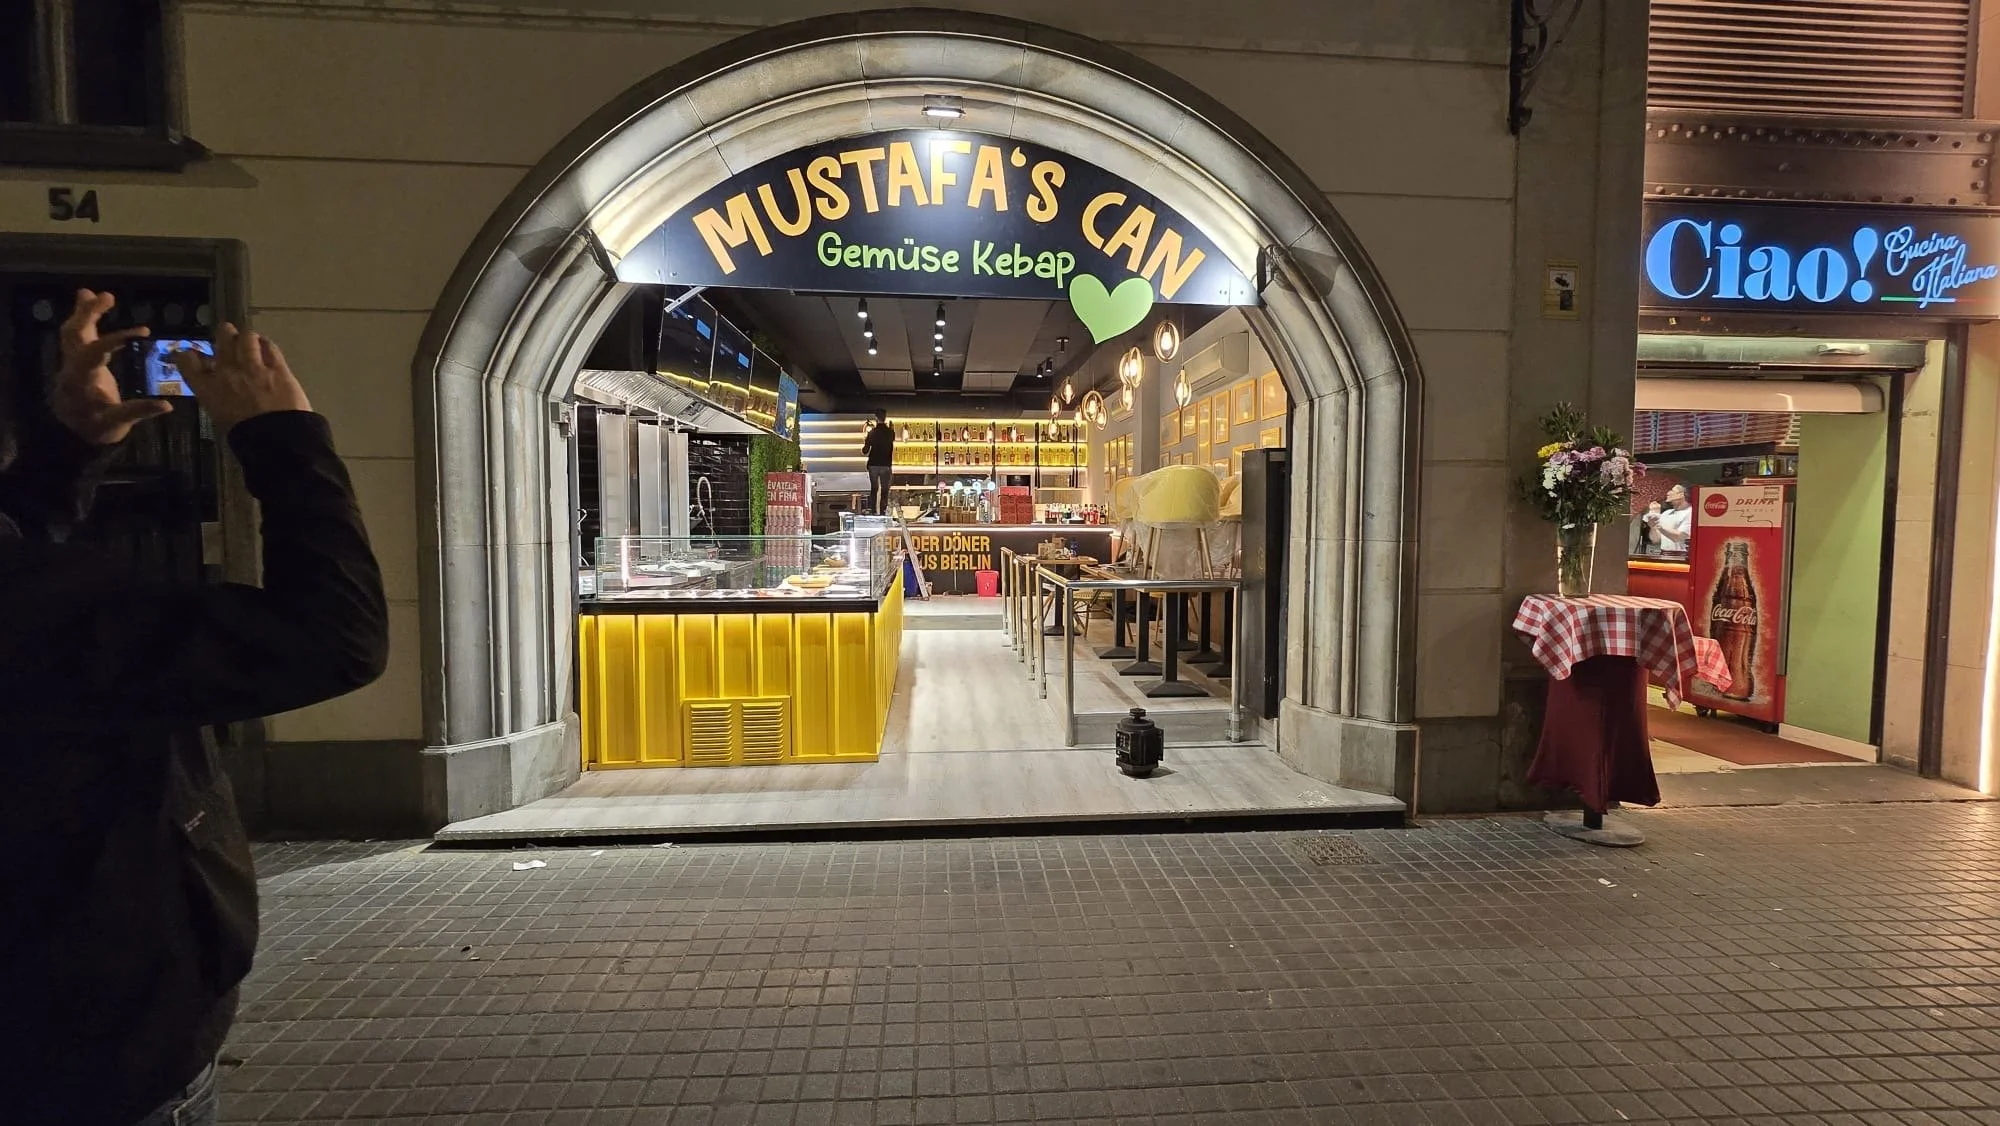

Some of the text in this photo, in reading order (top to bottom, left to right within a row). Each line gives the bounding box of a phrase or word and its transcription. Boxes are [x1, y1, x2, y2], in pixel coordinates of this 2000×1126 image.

[49, 187, 99, 223] 54
[692, 139, 1206, 300] MUSTAFA'S CAN
[817, 231, 1076, 289] Gemüse Kebap
[1645, 218, 1878, 303] Ciao!
[1884, 226, 1959, 276] Cucina
[1912, 243, 1998, 309] Italiana
[911, 535, 940, 552] DER
[943, 531, 990, 552] DÖNER
[918, 553, 991, 570] US BERLIN
[1711, 603, 1757, 626] Coca-Cola
